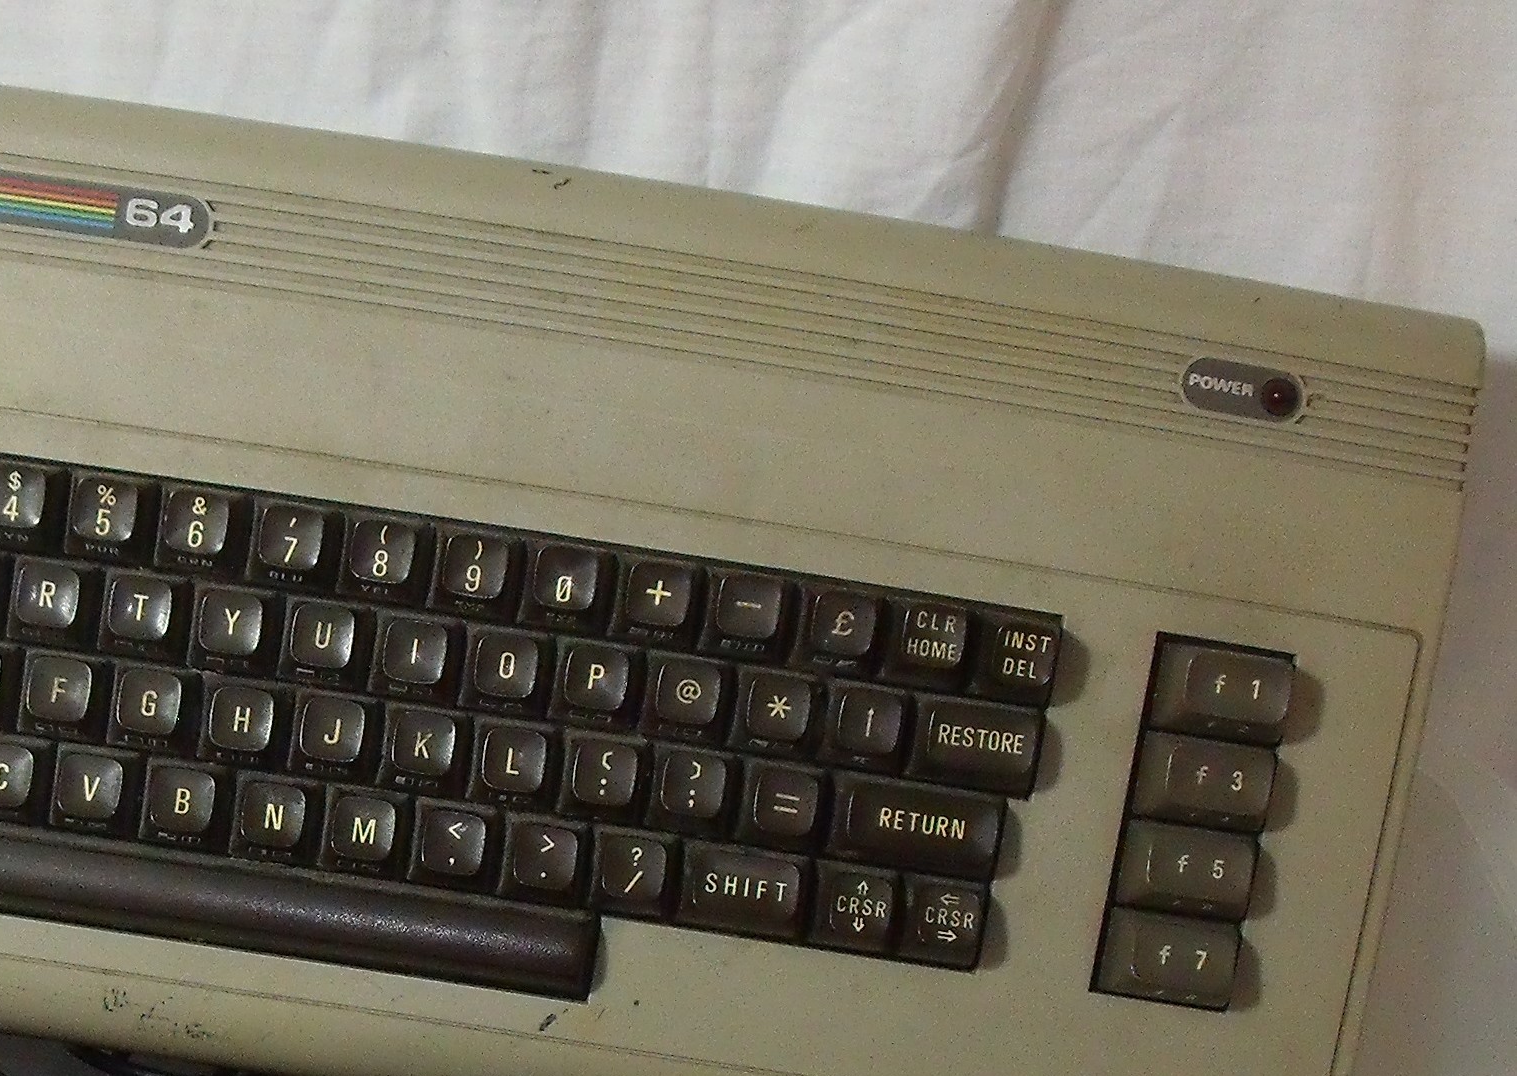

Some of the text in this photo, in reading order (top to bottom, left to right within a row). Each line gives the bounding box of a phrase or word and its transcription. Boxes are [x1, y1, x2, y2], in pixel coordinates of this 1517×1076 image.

[125, 199, 194, 235] 64
[1188, 372, 1255, 397] POWER
[2, 495, 19, 521] 4
[95, 508, 111, 536] 5
[187, 520, 204, 548] 6
[284, 536, 299, 563] 7
[372, 549, 389, 577] 8
[464, 564, 482, 593] 9
[38, 582, 57, 609] R
[132, 594, 149, 622] T
[224, 608, 242, 637] Y
[314, 621, 333, 650] U
[831, 610, 855, 637] £
[916, 611, 957, 633] CLR
[411, 639, 419, 665] I
[907, 638, 957, 661] HOME
[1004, 630, 1052, 653] INST
[498, 652, 517, 680] O
[587, 663, 605, 690] P
[1002, 657, 1037, 680] DEL
[50, 676, 68, 704] F
[140, 689, 159, 717] G
[676, 679, 702, 704] @
[232, 706, 251, 734] H
[323, 718, 343, 745] J
[413, 731, 431, 760] K
[937, 723, 1024, 755] RESTORE
[505, 747, 521, 776] L
[83, 773, 101, 803] V
[174, 787, 192, 816] B
[263, 802, 284, 832] N
[879, 807, 966, 840] RETURN
[352, 817, 377, 846] M
[704, 872, 788, 902] SHIFT
[836, 895, 887, 918] CRSR
[925, 906, 974, 929] CRSR
